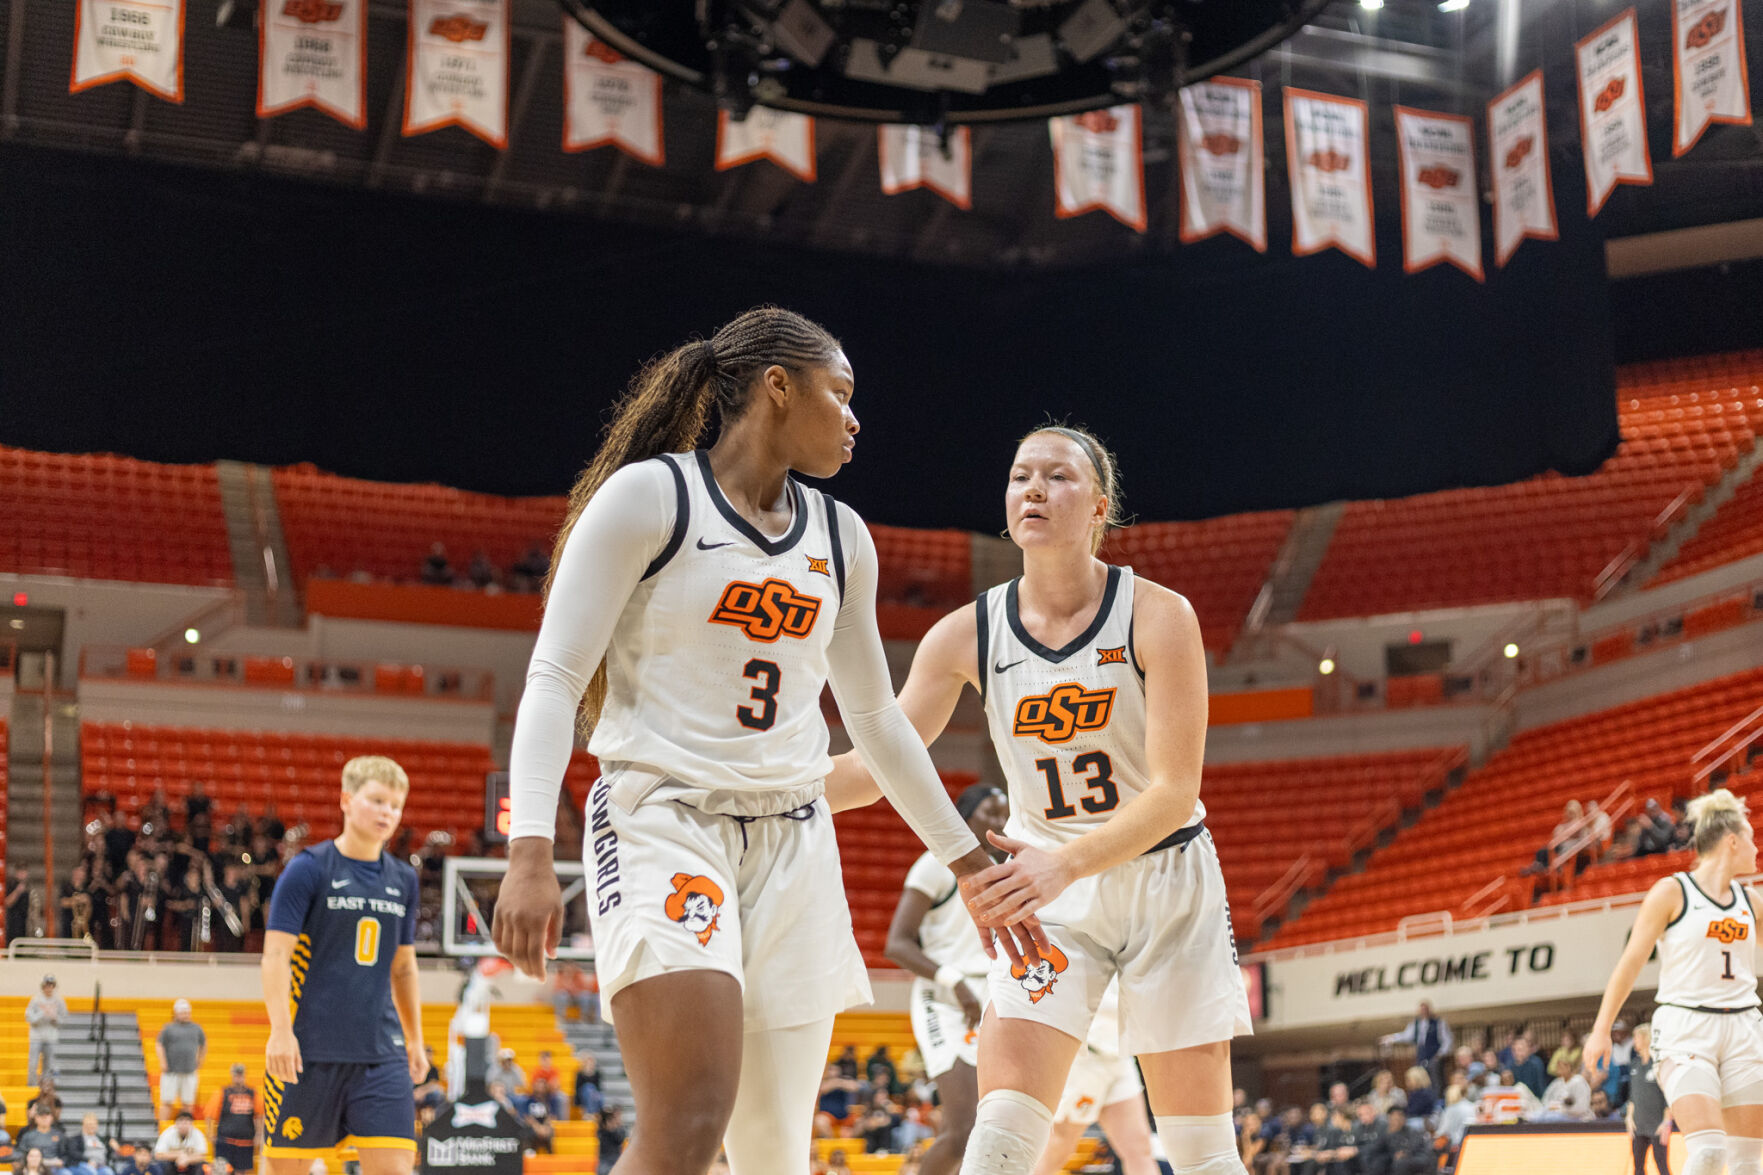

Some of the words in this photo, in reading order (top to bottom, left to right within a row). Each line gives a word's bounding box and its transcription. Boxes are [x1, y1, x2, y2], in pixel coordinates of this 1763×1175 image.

[708, 578, 822, 643] OSU
[736, 658, 782, 731] 3
[1013, 682, 1117, 744] OSU
[1035, 750, 1120, 820] 13
[592, 777, 622, 917] OWGIRLS
[326, 896, 366, 911] EAST
[368, 898, 406, 918] TEXAS
[1706, 917, 1749, 944] OSU
[355, 916, 381, 966] 0
[1335, 951, 1493, 997] WELCOME
[1506, 941, 1556, 974] TO
[1720, 950, 1736, 980] 1
